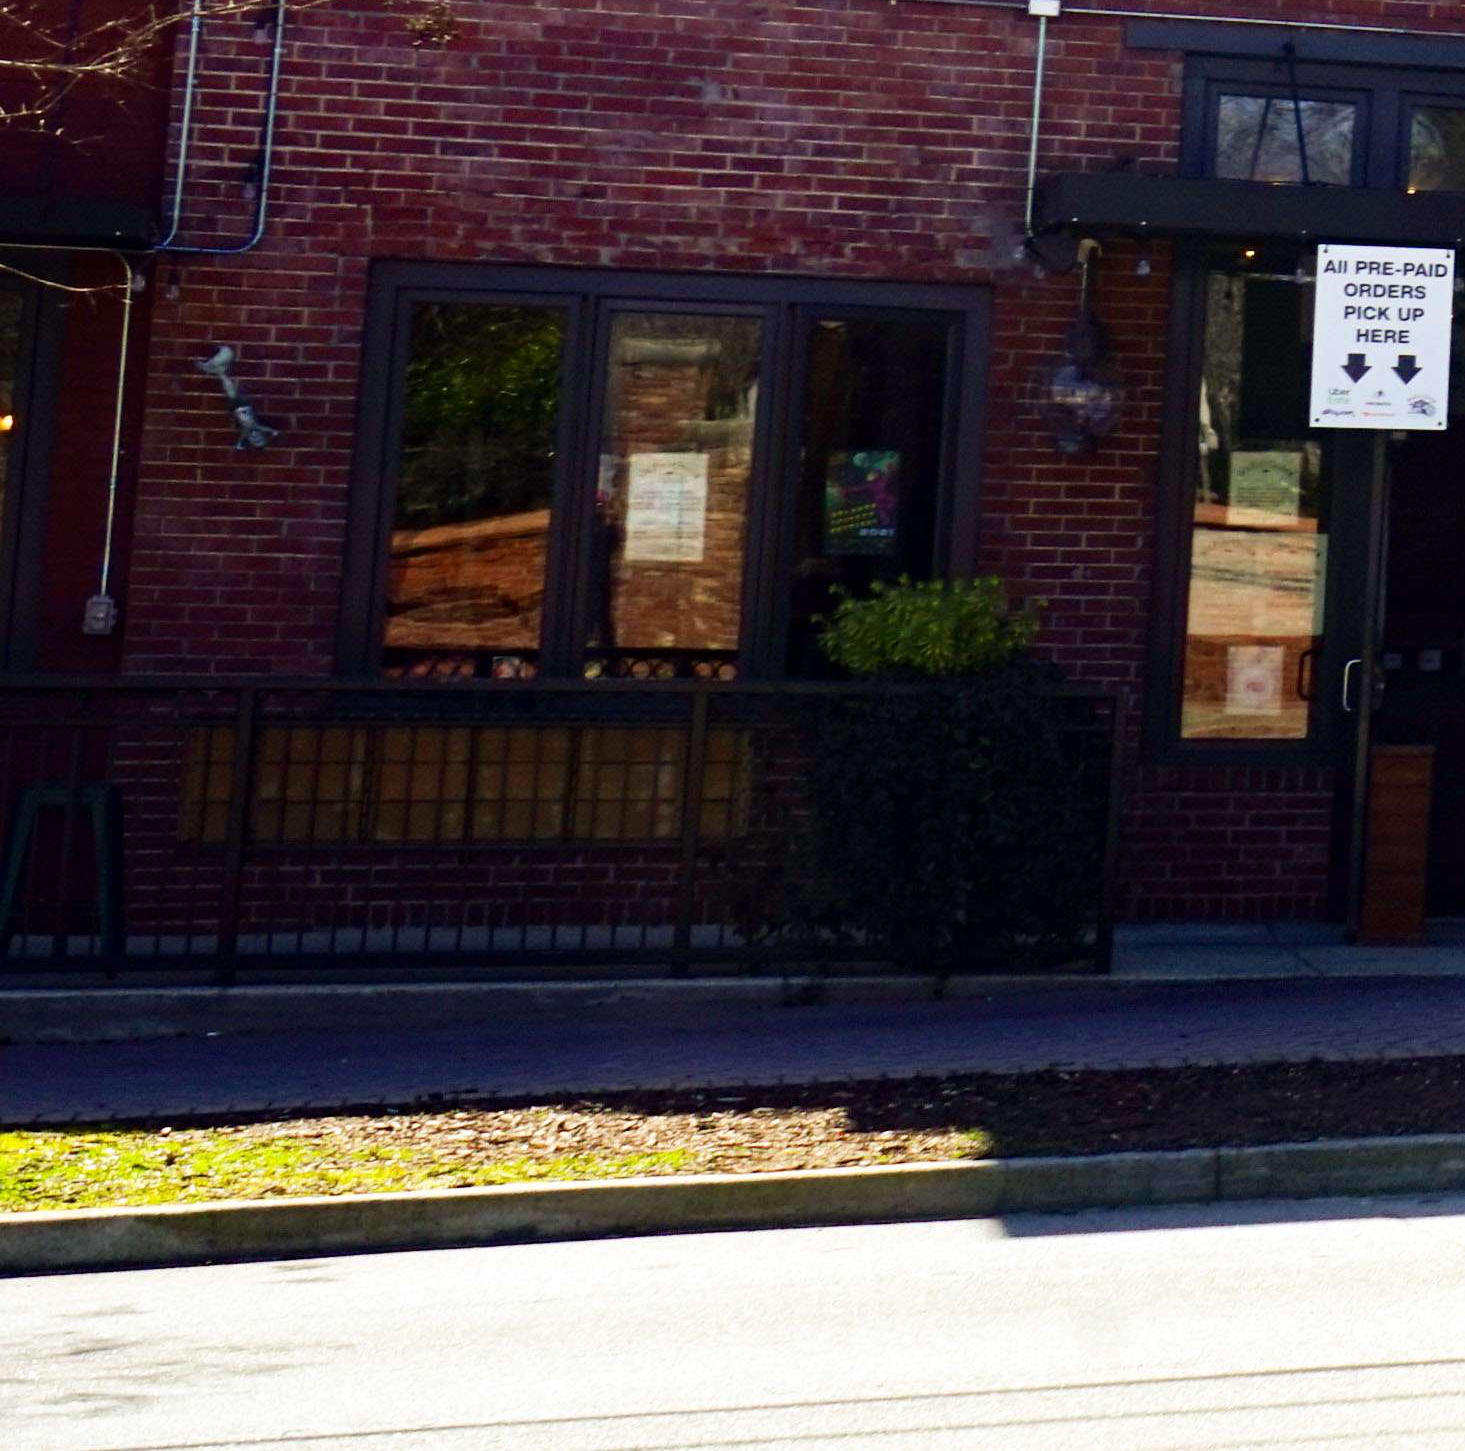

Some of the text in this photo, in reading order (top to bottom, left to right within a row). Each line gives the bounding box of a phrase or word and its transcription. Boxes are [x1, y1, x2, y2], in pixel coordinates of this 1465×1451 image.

[1355, 261, 1448, 278] PRE-PAID
[1343, 283, 1426, 299] ORDERS
[1343, 305, 1425, 322] PICK UP
[1356, 328, 1410, 344] HERE
